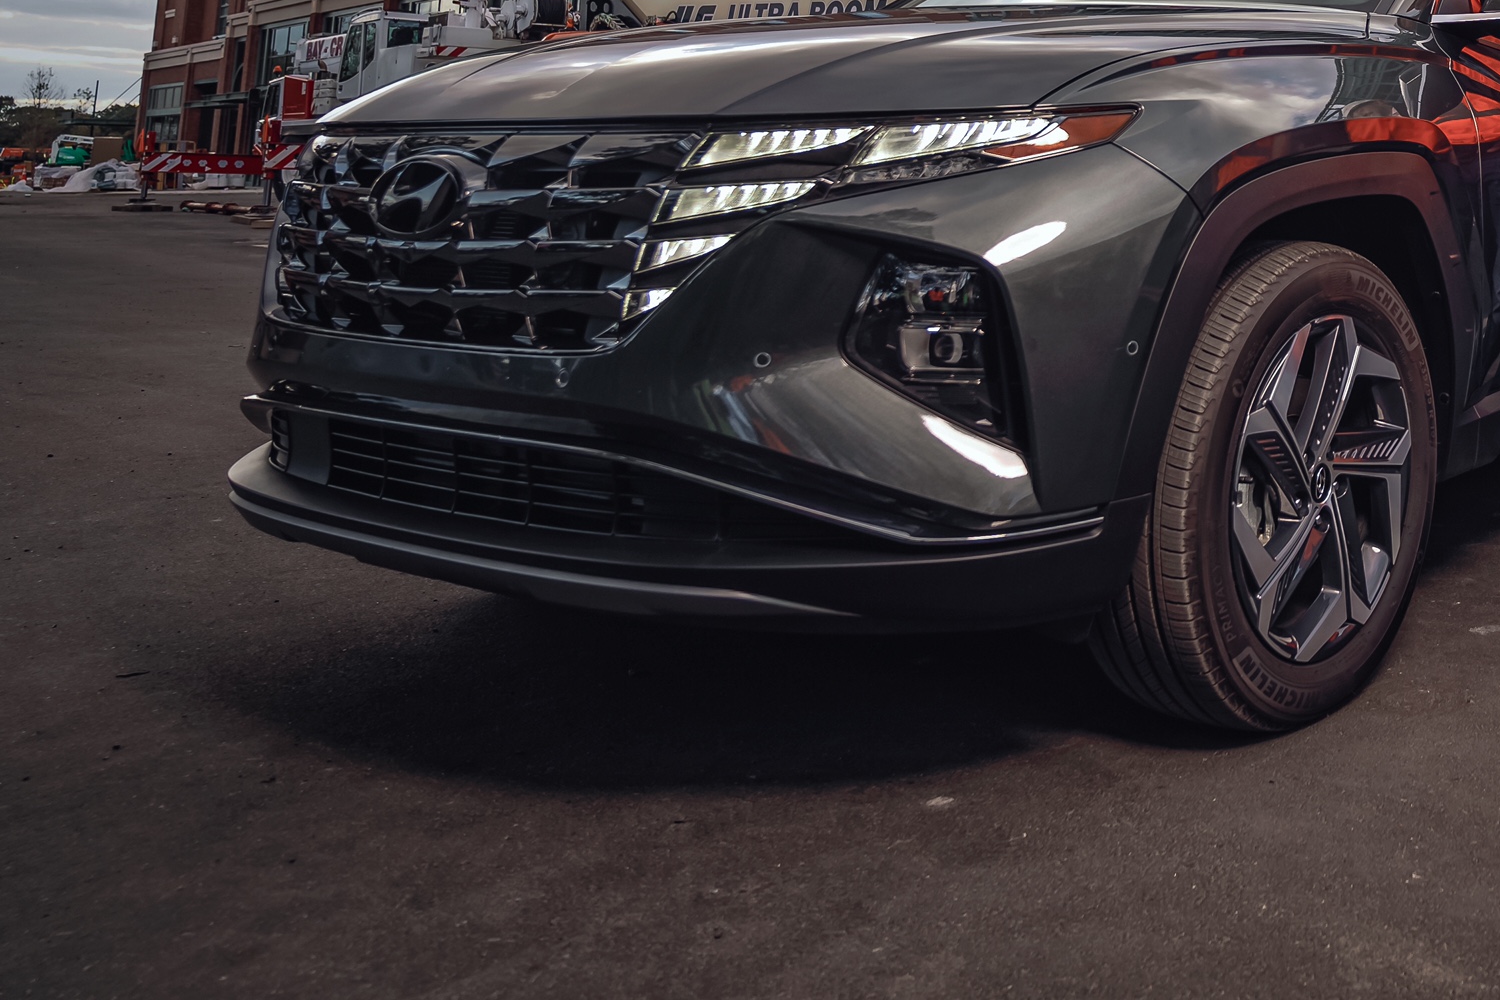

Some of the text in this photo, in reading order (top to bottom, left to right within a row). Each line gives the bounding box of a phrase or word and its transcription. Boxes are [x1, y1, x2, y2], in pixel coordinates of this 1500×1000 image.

[306, 39, 325, 60] BAY
[1356, 275, 1418, 348] MICHELIN
[1211, 562, 1237, 643] PRIMACY
[1239, 654, 1321, 709] MICHELIN
